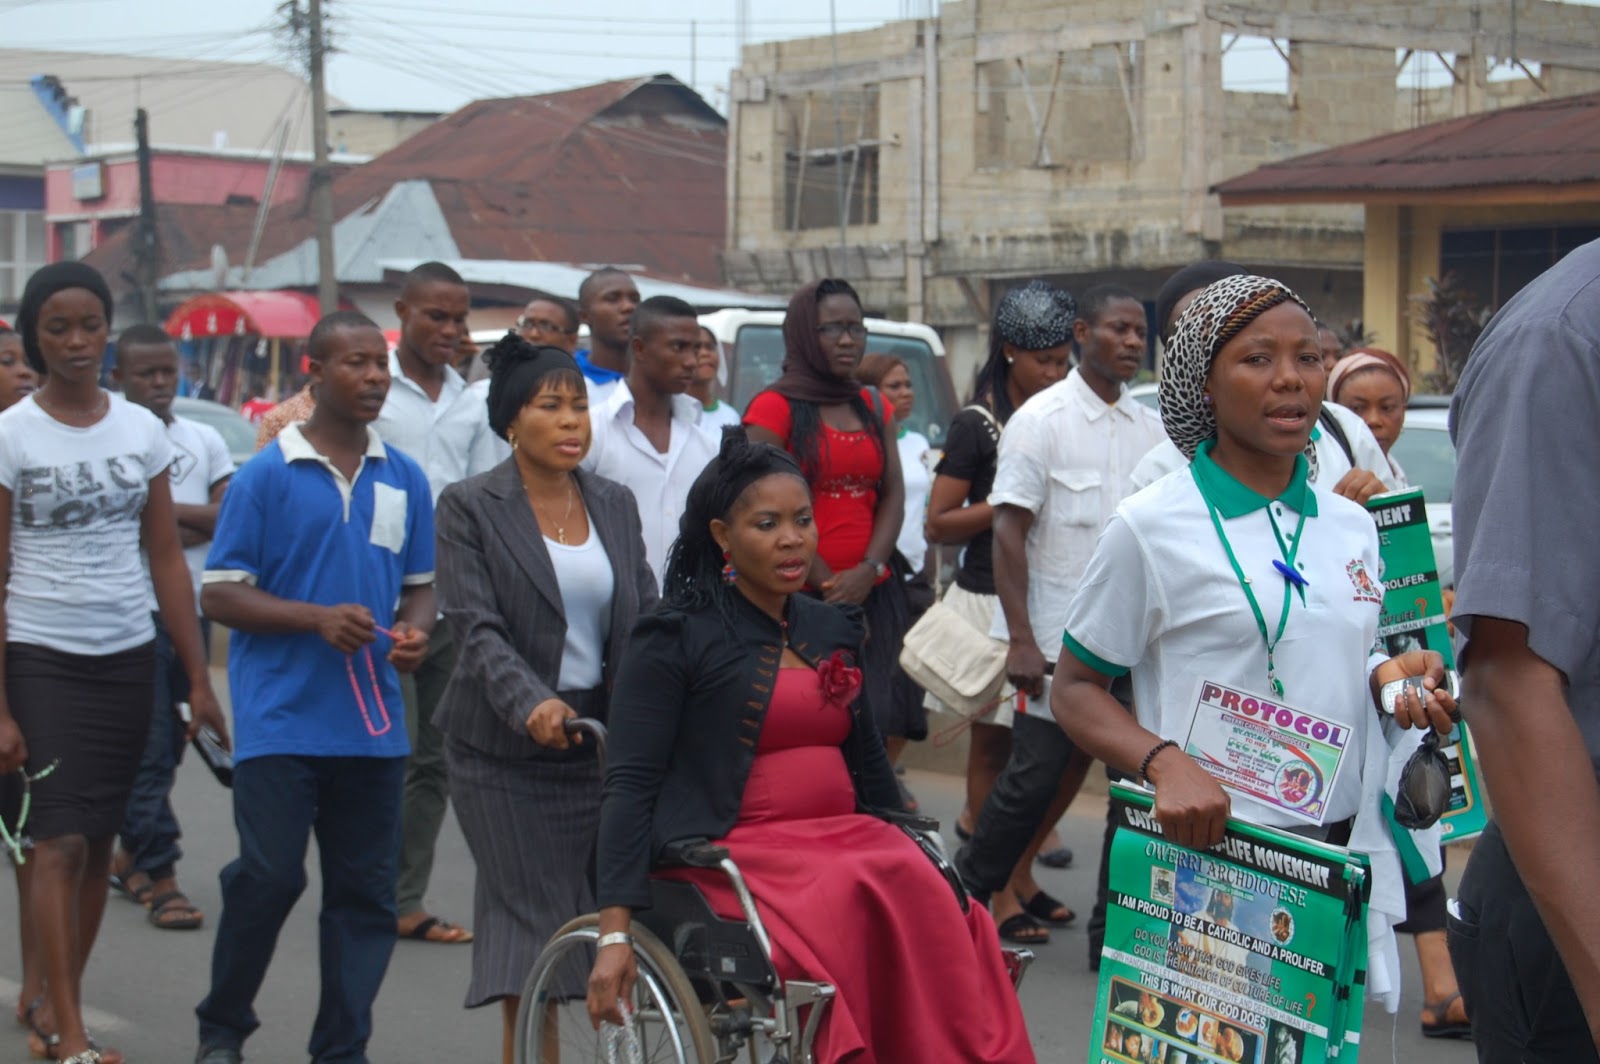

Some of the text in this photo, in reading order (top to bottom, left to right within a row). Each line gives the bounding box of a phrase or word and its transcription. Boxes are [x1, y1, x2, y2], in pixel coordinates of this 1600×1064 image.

[1371, 505, 1412, 527] MENT
[1383, 573, 1428, 590] ROLIFER.
[1395, 610, 1415, 622] LIFE
[1202, 684, 1344, 748] PROTOCOL
[1125, 806, 1163, 834] CATH
[1254, 845, 1329, 889] MOVEMENT
[1145, 841, 1205, 874] OWERRI
[1117, 893, 1325, 977] I AM PROUD TO BE A CATHOLIC AND A PROLIFER.
[1135, 928, 1148, 941] DO
[1149, 932, 1166, 949] YOU
[1166, 940, 1194, 957] KNOW
[1216, 957, 1235, 973] GOD
[1236, 963, 1261, 983] GIVES
[1111, 951, 1125, 962] JOIN
[1125, 955, 1146, 969] HANDS
[1146, 961, 1159, 973] AND
[1239, 997, 1252, 1009] AND
[1253, 1002, 1278, 1019] DEFEND
[1279, 1011, 1301, 1027] HUMAN
[1133, 944, 1152, 959] GOD
[1153, 948, 1161, 961] IS
[1179, 959, 1219, 984] INITIATOR
[1220, 975, 1231, 988] OF
[1232, 980, 1271, 1002] CULTURE
[1272, 994, 1284, 1007] OF
[1285, 1000, 1304, 1015] LIFE
[1140, 971, 1159, 989] THIS
[1160, 978, 1170, 993] IS
[1171, 982, 1197, 1003] WHAT
[1197, 994, 1217, 1012] OUR
[1219, 1001, 1239, 1019] GOD
